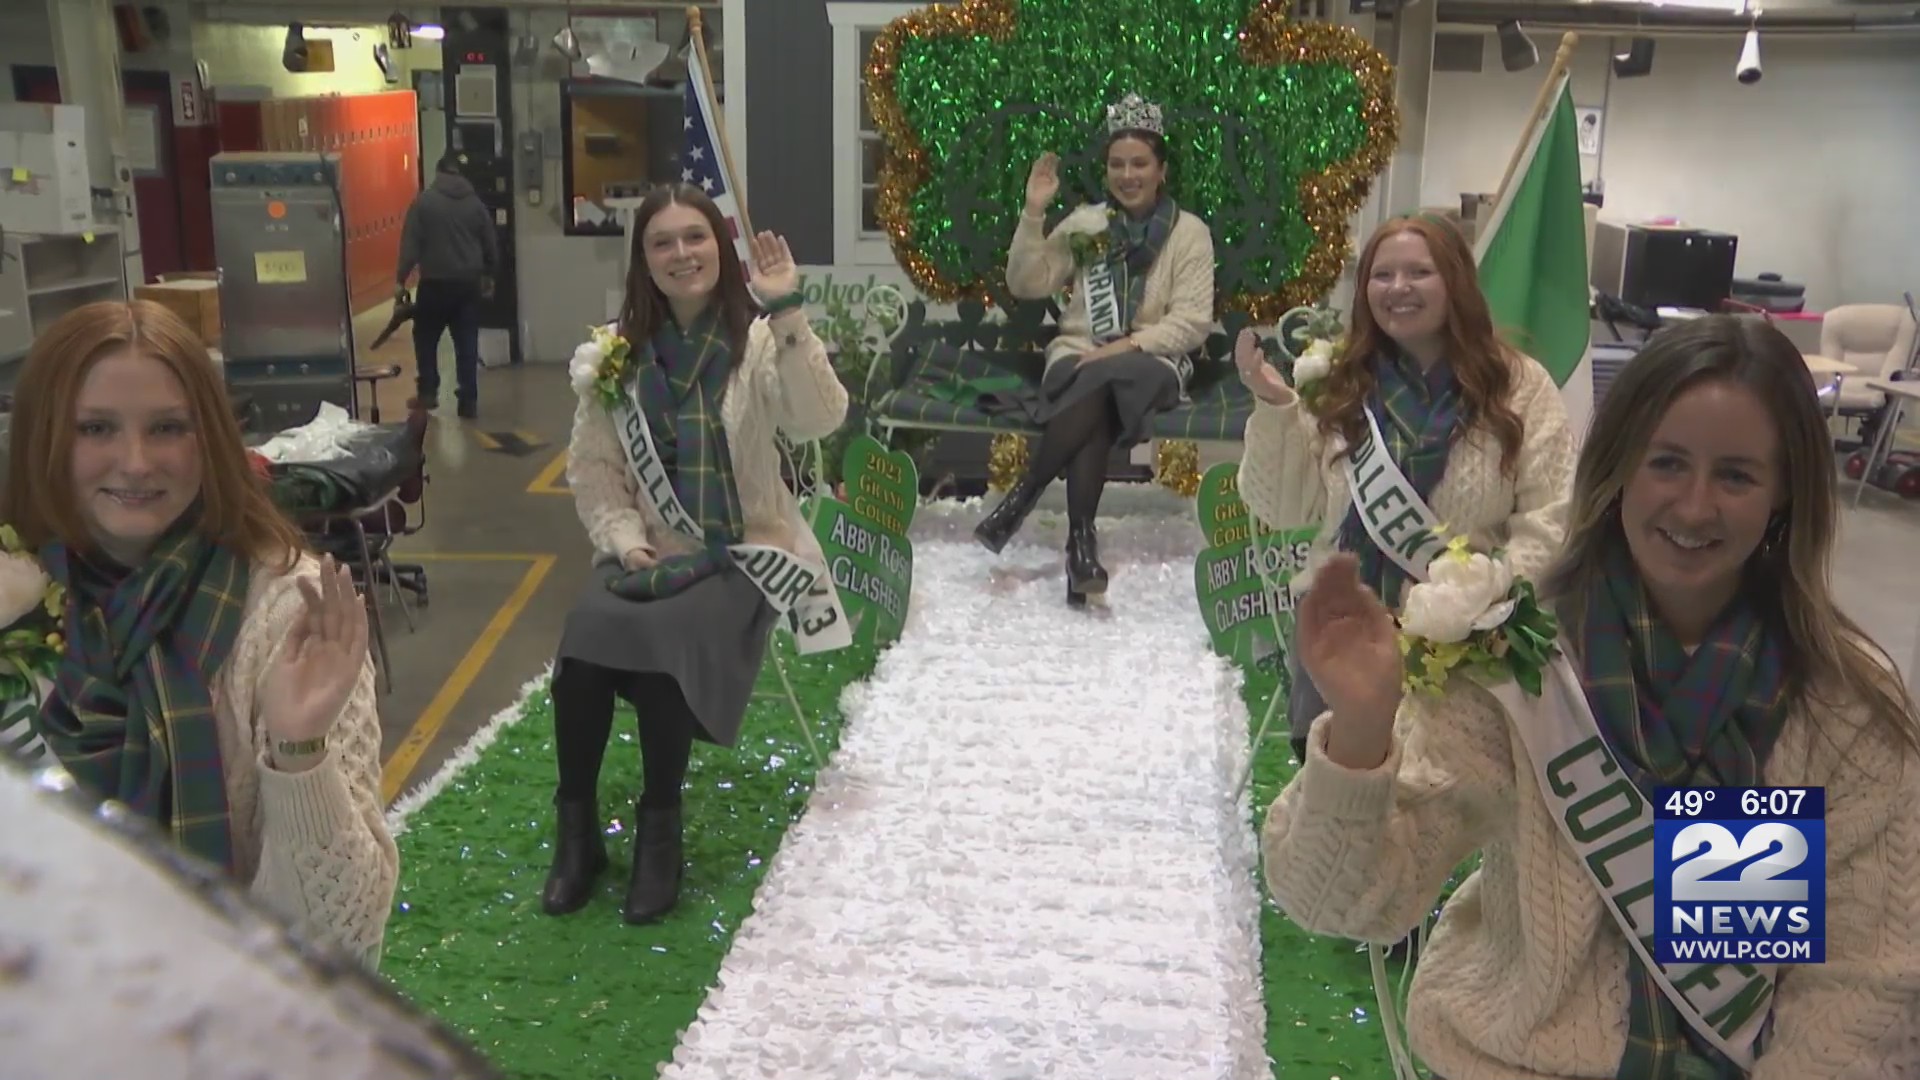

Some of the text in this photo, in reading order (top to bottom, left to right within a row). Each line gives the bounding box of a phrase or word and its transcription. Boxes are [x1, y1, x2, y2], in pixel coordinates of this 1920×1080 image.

[1088, 261, 1114, 335] GRAND
[626, 410, 695, 535] COLLEE
[866, 452, 902, 484] 2023
[860, 473, 904, 511] GRAND
[1214, 502, 1249, 522] GRA
[1350, 431, 1439, 561] OLLEEN
[830, 513, 877, 558] ABBY
[854, 495, 904, 536] COLLEEN
[1213, 521, 1272, 548] COLL
[831, 556, 900, 620] GLASHEE
[1207, 555, 1240, 594] ABBY
[1215, 585, 1298, 633] GLASHE
[1547, 735, 1773, 1041] COLLEN
